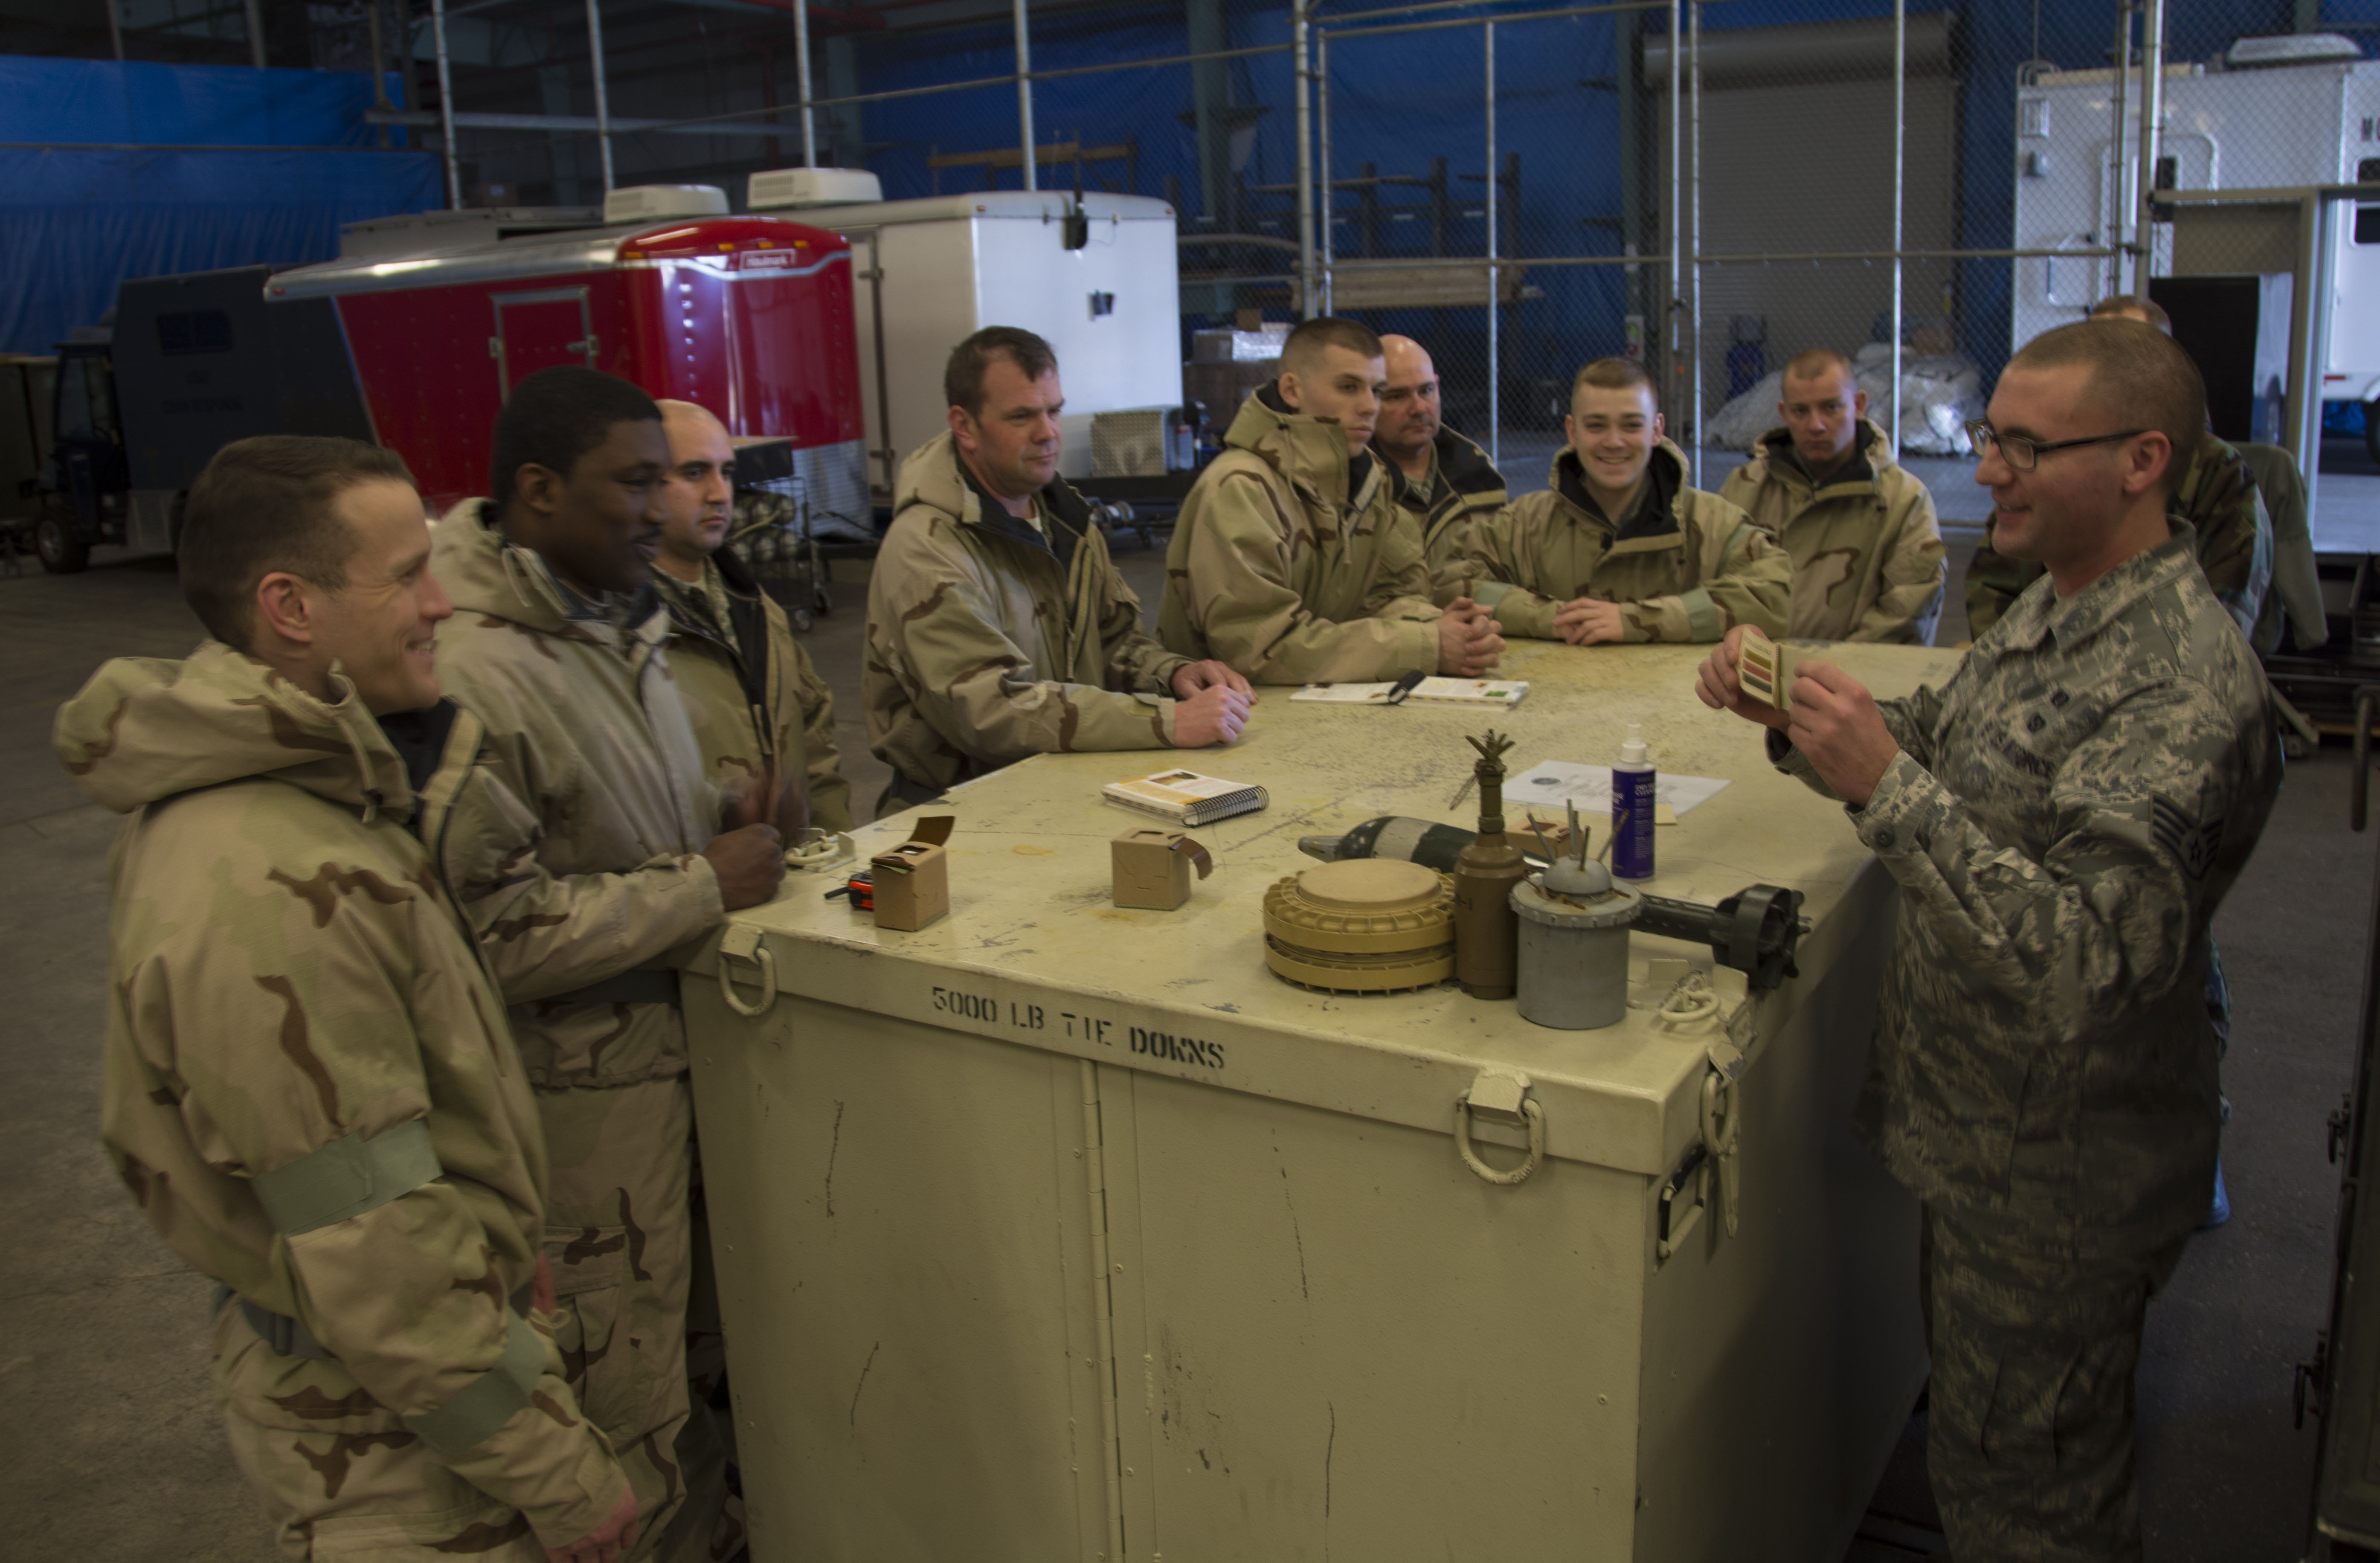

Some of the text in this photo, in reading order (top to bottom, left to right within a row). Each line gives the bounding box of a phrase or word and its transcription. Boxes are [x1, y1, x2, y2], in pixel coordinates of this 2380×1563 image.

[932, 986, 1224, 1069] 5000 LB TIE DOWNS
